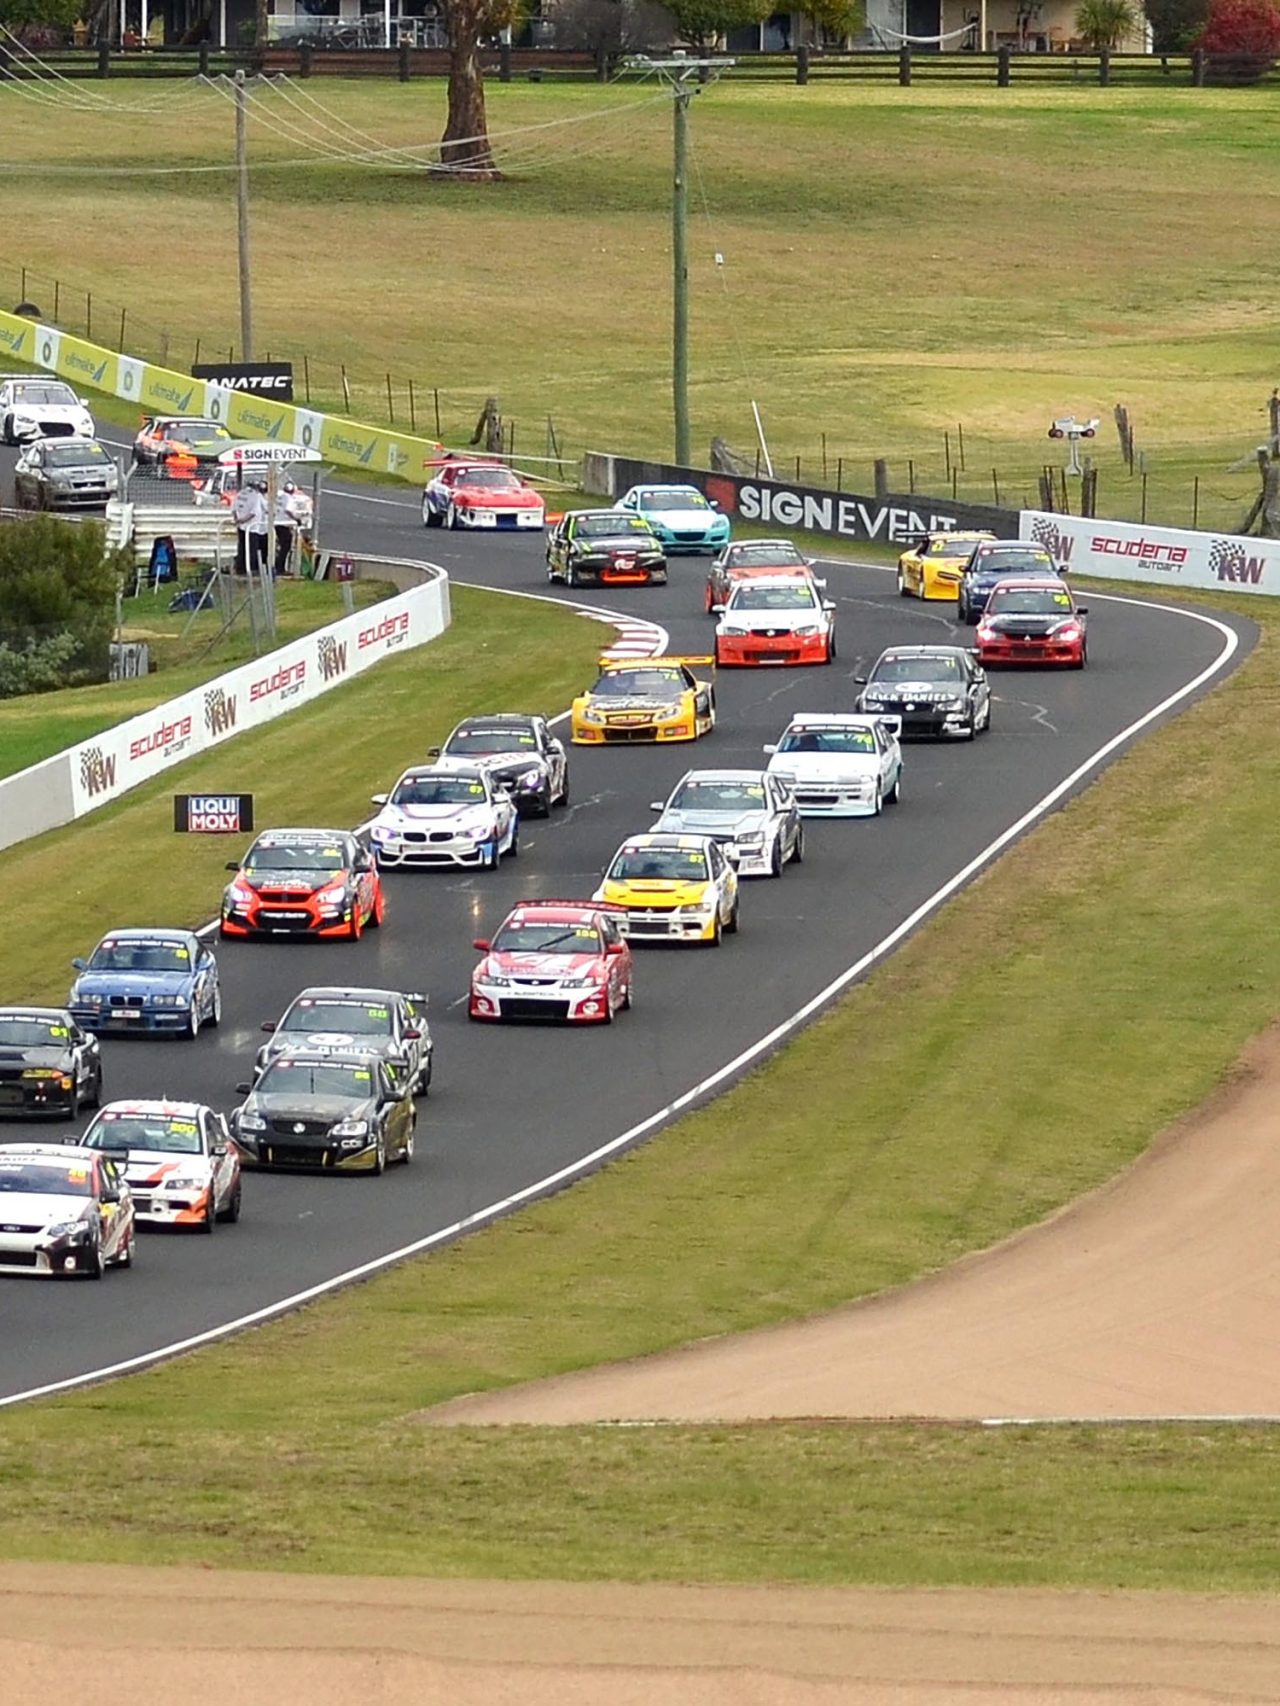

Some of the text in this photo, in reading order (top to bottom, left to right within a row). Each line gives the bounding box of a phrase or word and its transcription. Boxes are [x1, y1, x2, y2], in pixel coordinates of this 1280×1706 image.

[1090, 536, 1189, 563] scuderia
[1217, 555, 1267, 584] KW
[357, 612, 409, 650] scuderia
[250, 660, 306, 702] scuderia
[130, 715, 192, 761] scuderia
[191, 799, 236, 814] LIQUI
[191, 814, 237, 829] MOLY
